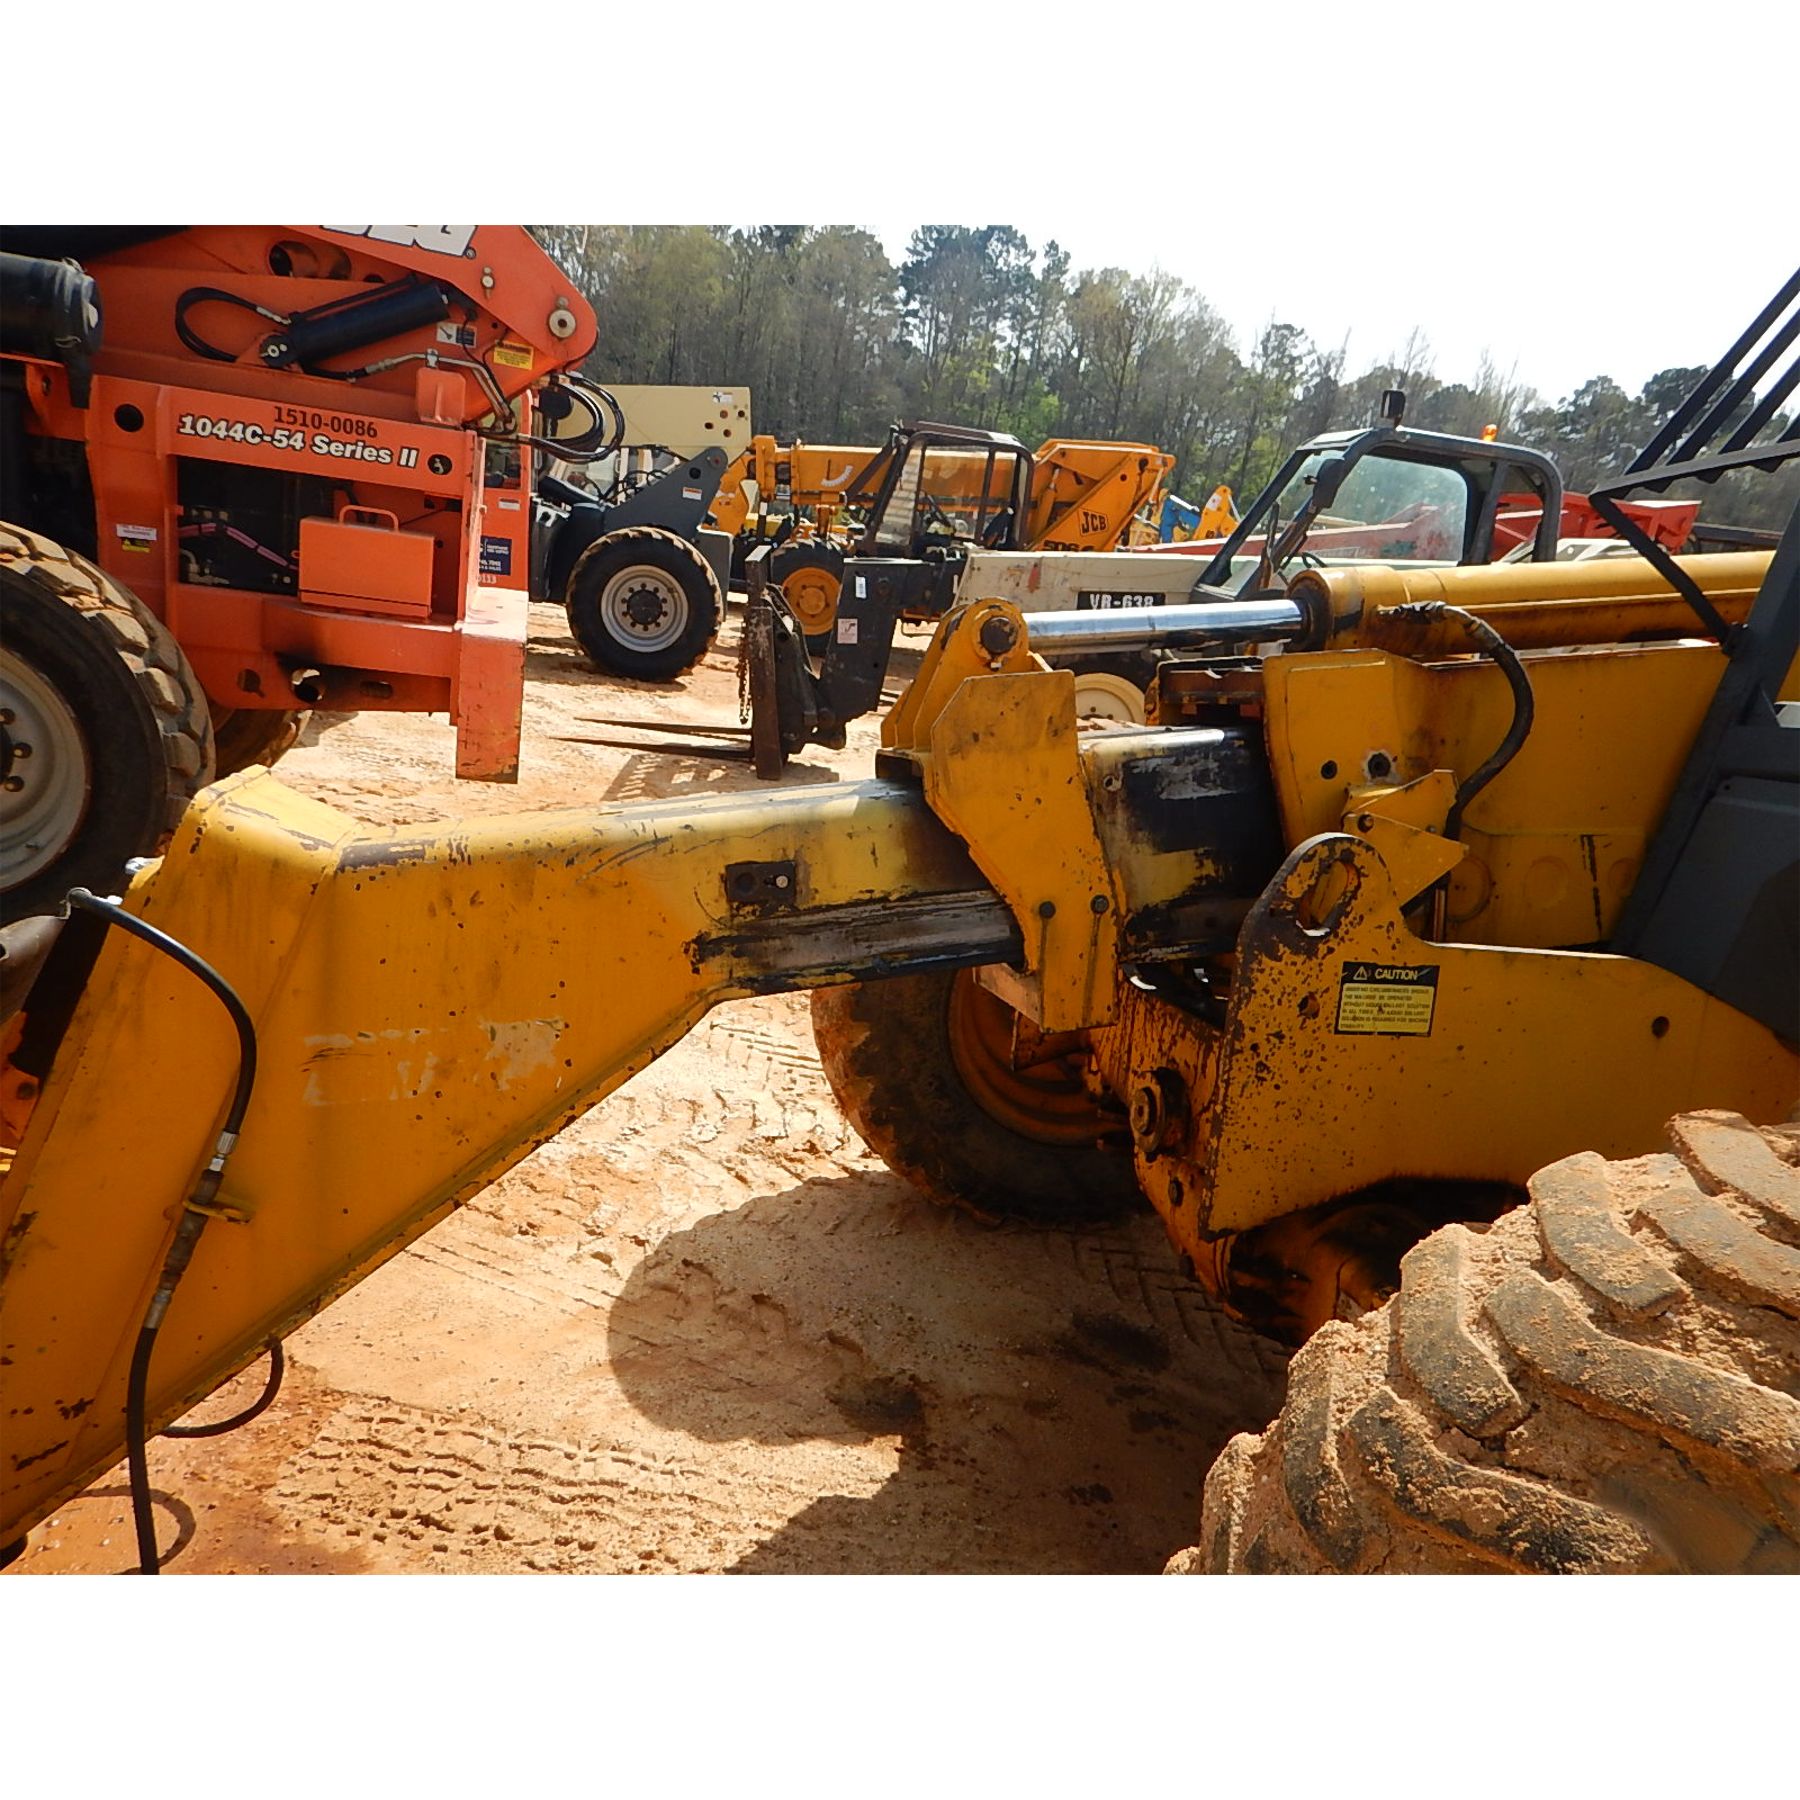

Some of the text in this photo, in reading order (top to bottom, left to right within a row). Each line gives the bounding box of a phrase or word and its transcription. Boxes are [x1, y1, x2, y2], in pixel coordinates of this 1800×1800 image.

[273, 406, 378, 438] 1510-0086
[177, 413, 305, 451] 1044C-54
[311, 434, 393, 465] Series
[1081, 511, 1107, 533] JCB
[1089, 593, 1154, 609] VR-638
[1374, 968, 1418, 980] CAUTION
